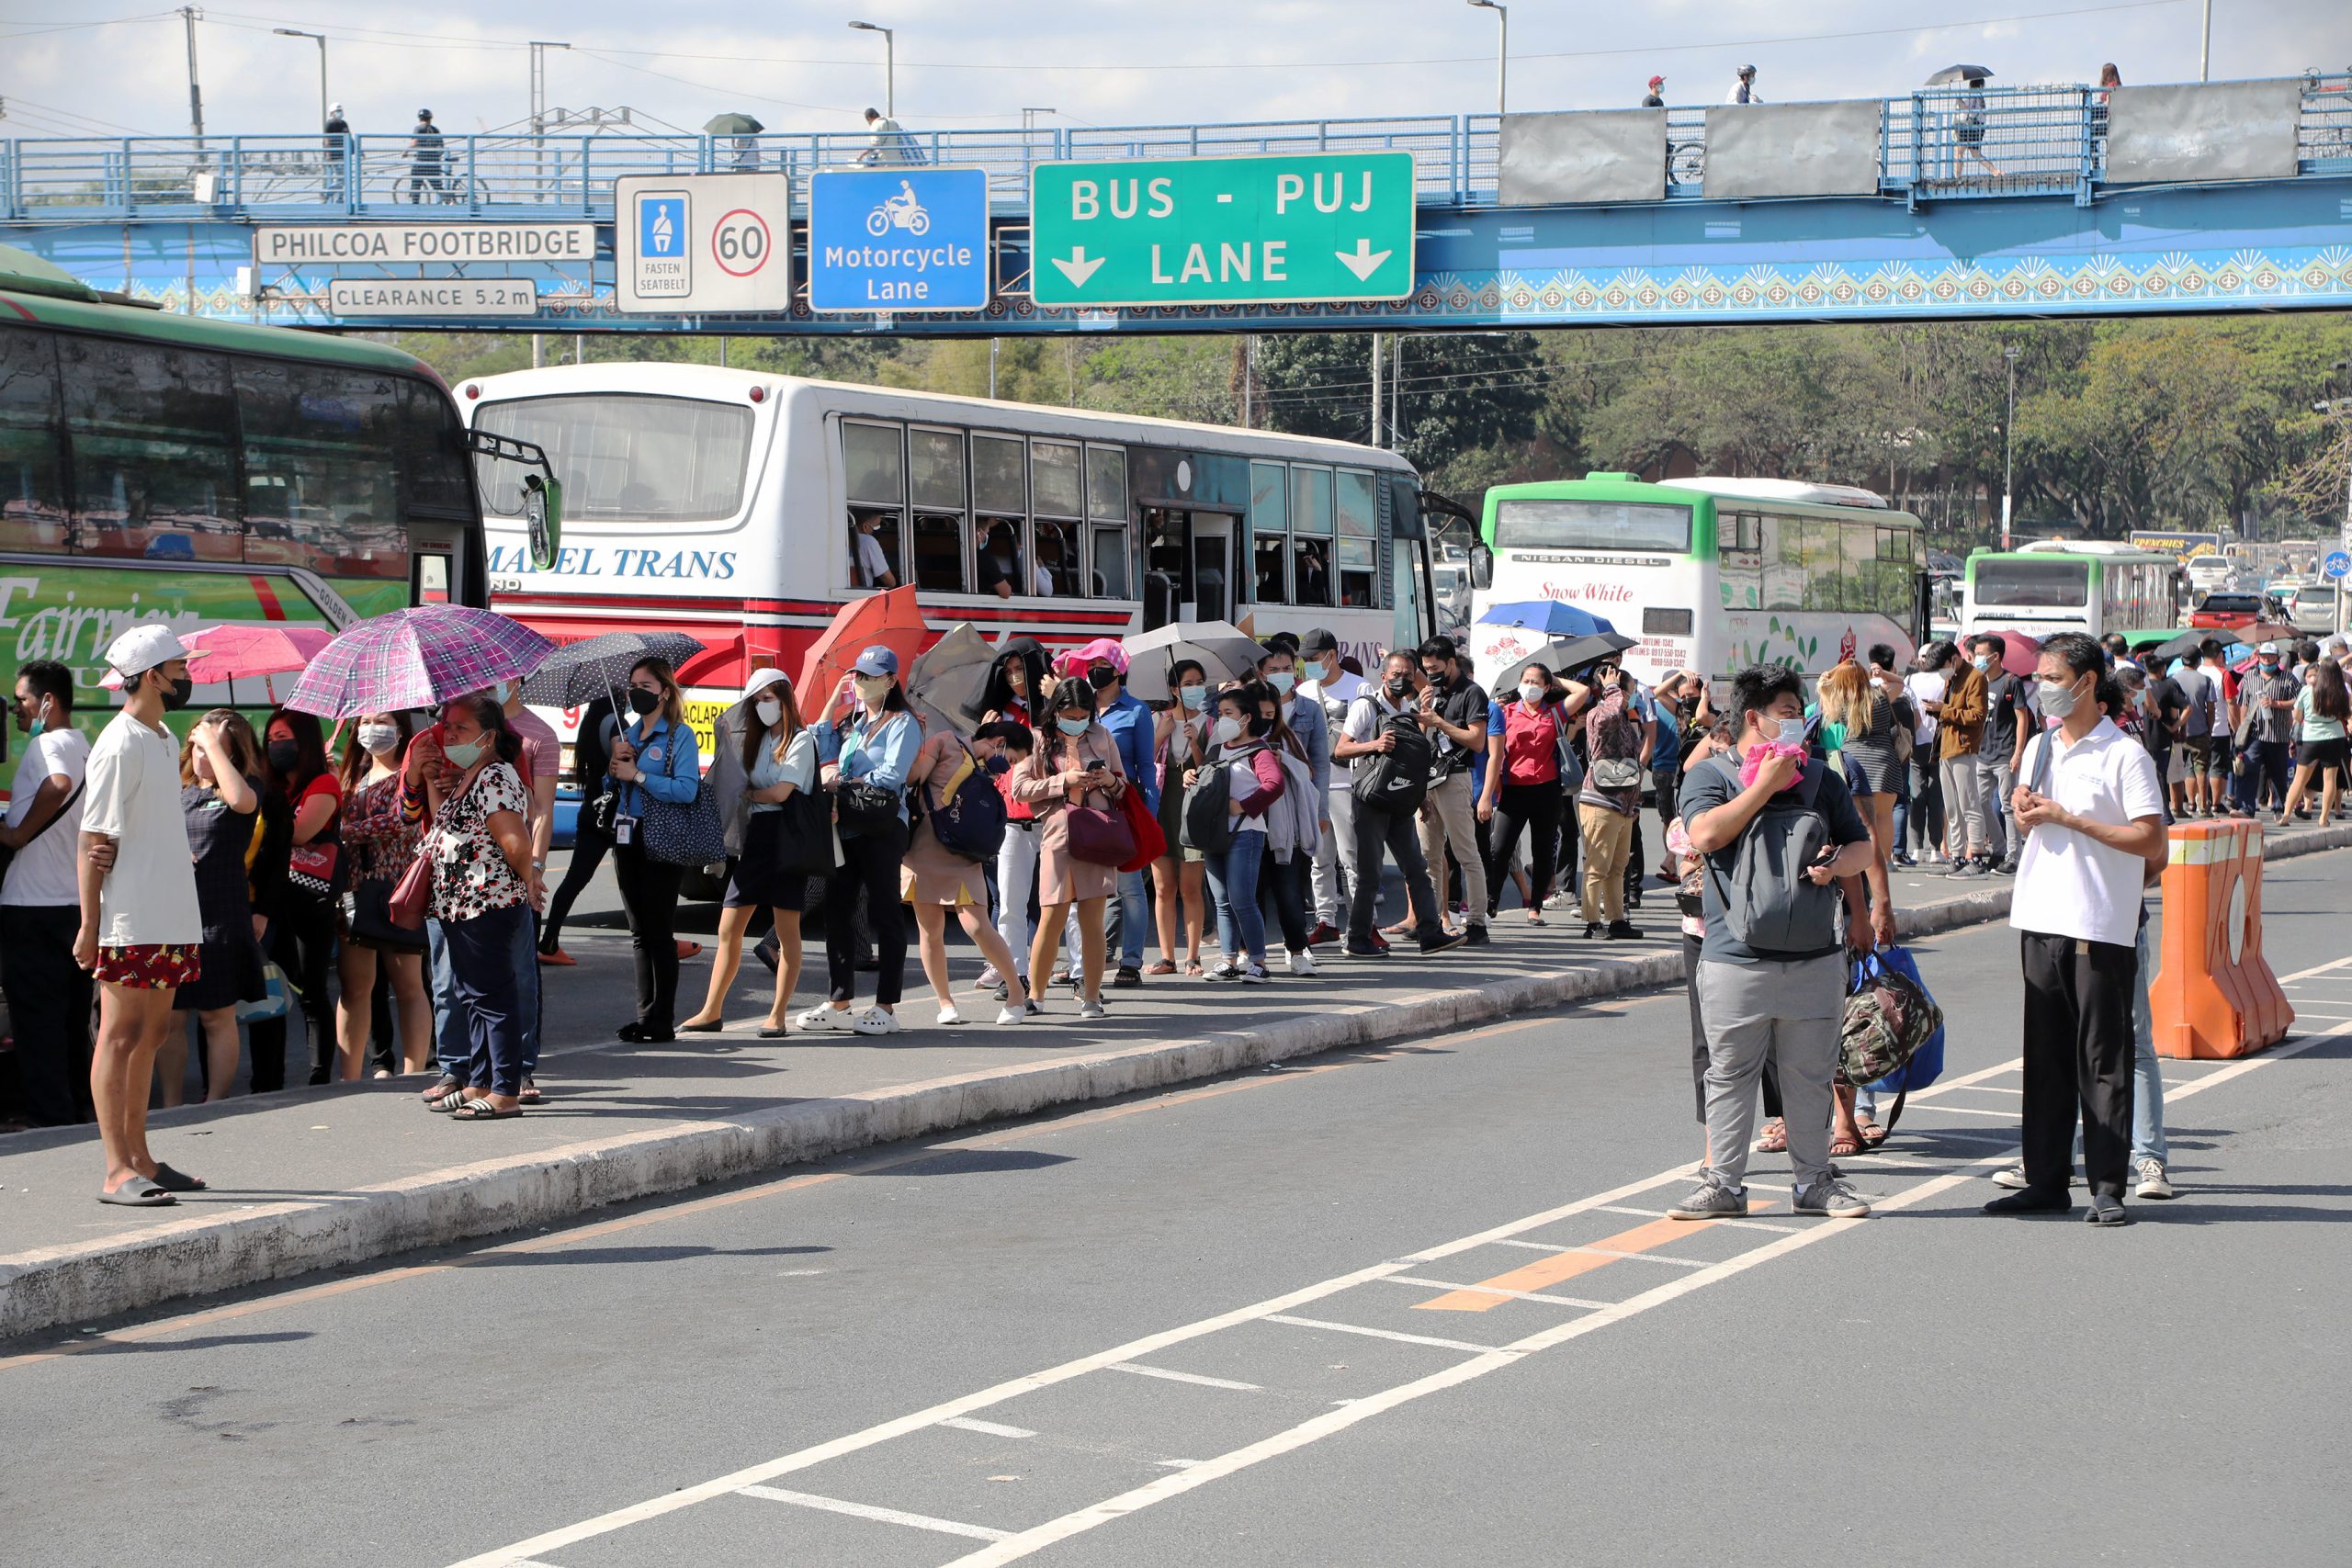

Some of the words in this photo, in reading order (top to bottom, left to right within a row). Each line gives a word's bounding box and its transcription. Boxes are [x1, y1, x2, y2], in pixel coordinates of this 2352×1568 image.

[1071, 177, 1175, 220] BUS
[1276, 171, 1372, 214] PUJ
[272, 231, 388, 257] PHILCOA
[403, 229, 581, 256] FOOTBRIDGE
[719, 225, 763, 260] 60
[645, 263, 681, 276] FASTEN
[824, 243, 972, 273] Motorcycle
[1151, 241, 1288, 285] LANE
[640, 278, 685, 291] SEATBELT
[866, 278, 929, 300] Lane
[336, 288, 462, 307] CLEARANCE
[475, 288, 506, 306] 5.2
[513, 291, 530, 305] m
[488, 546, 602, 575] MAEL
[613, 548, 737, 580] TRANS
[1521, 554, 1585, 563] NISSAN
[1594, 556, 1659, 566] DIESEL
[1539, 581, 1581, 600] Snow
[1582, 582, 1634, 602] White
[320, 588, 347, 625] GOLDEN
[1337, 641, 1383, 670] RANS
[684, 705, 729, 725] ACLAR
[1393, 776, 1411, 785] NIKE
